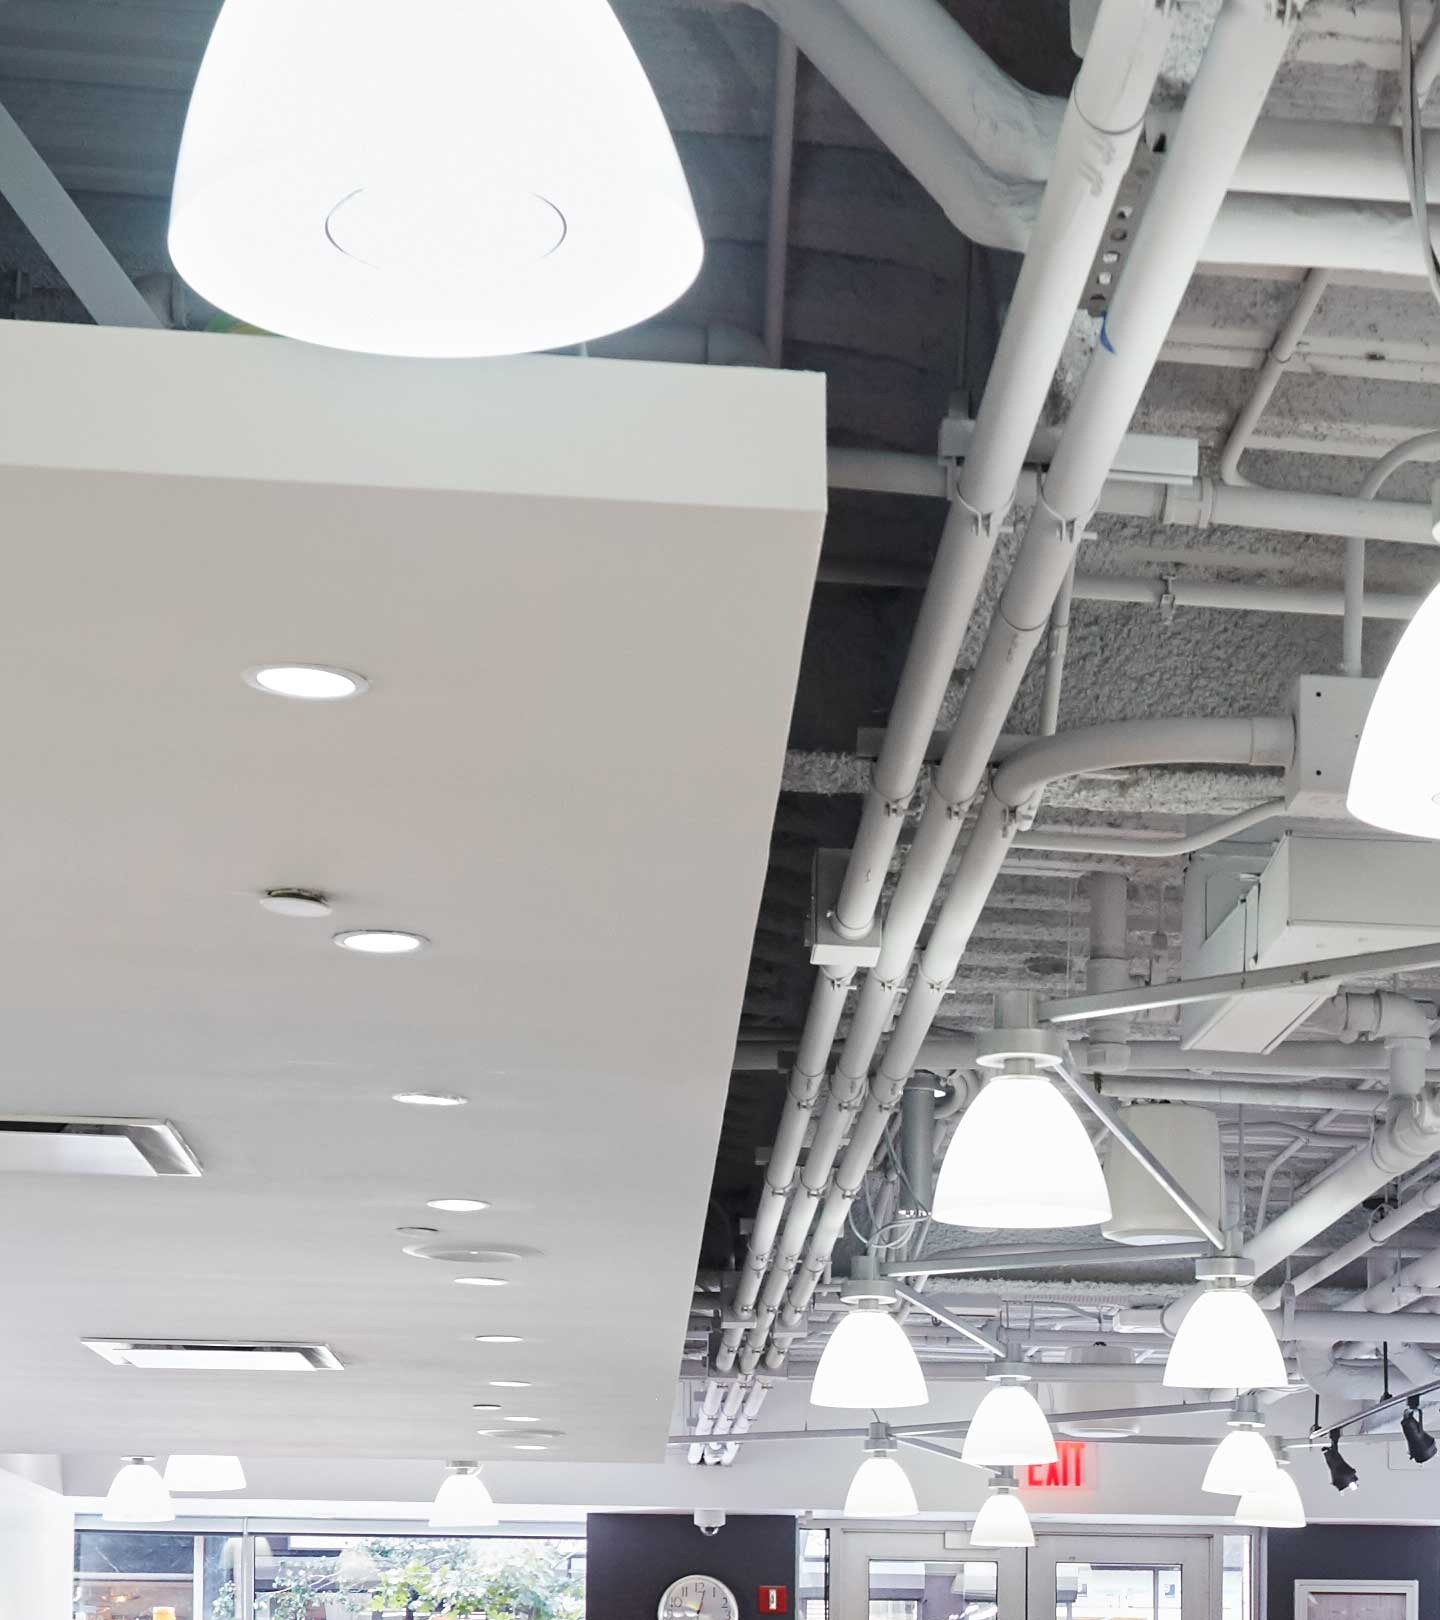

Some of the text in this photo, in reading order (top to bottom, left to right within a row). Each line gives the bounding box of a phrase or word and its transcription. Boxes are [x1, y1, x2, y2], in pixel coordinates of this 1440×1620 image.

[681, 1586, 688, 1597] 11
[694, 1582, 705, 1594] 12
[721, 1597, 728, 1608] 2
